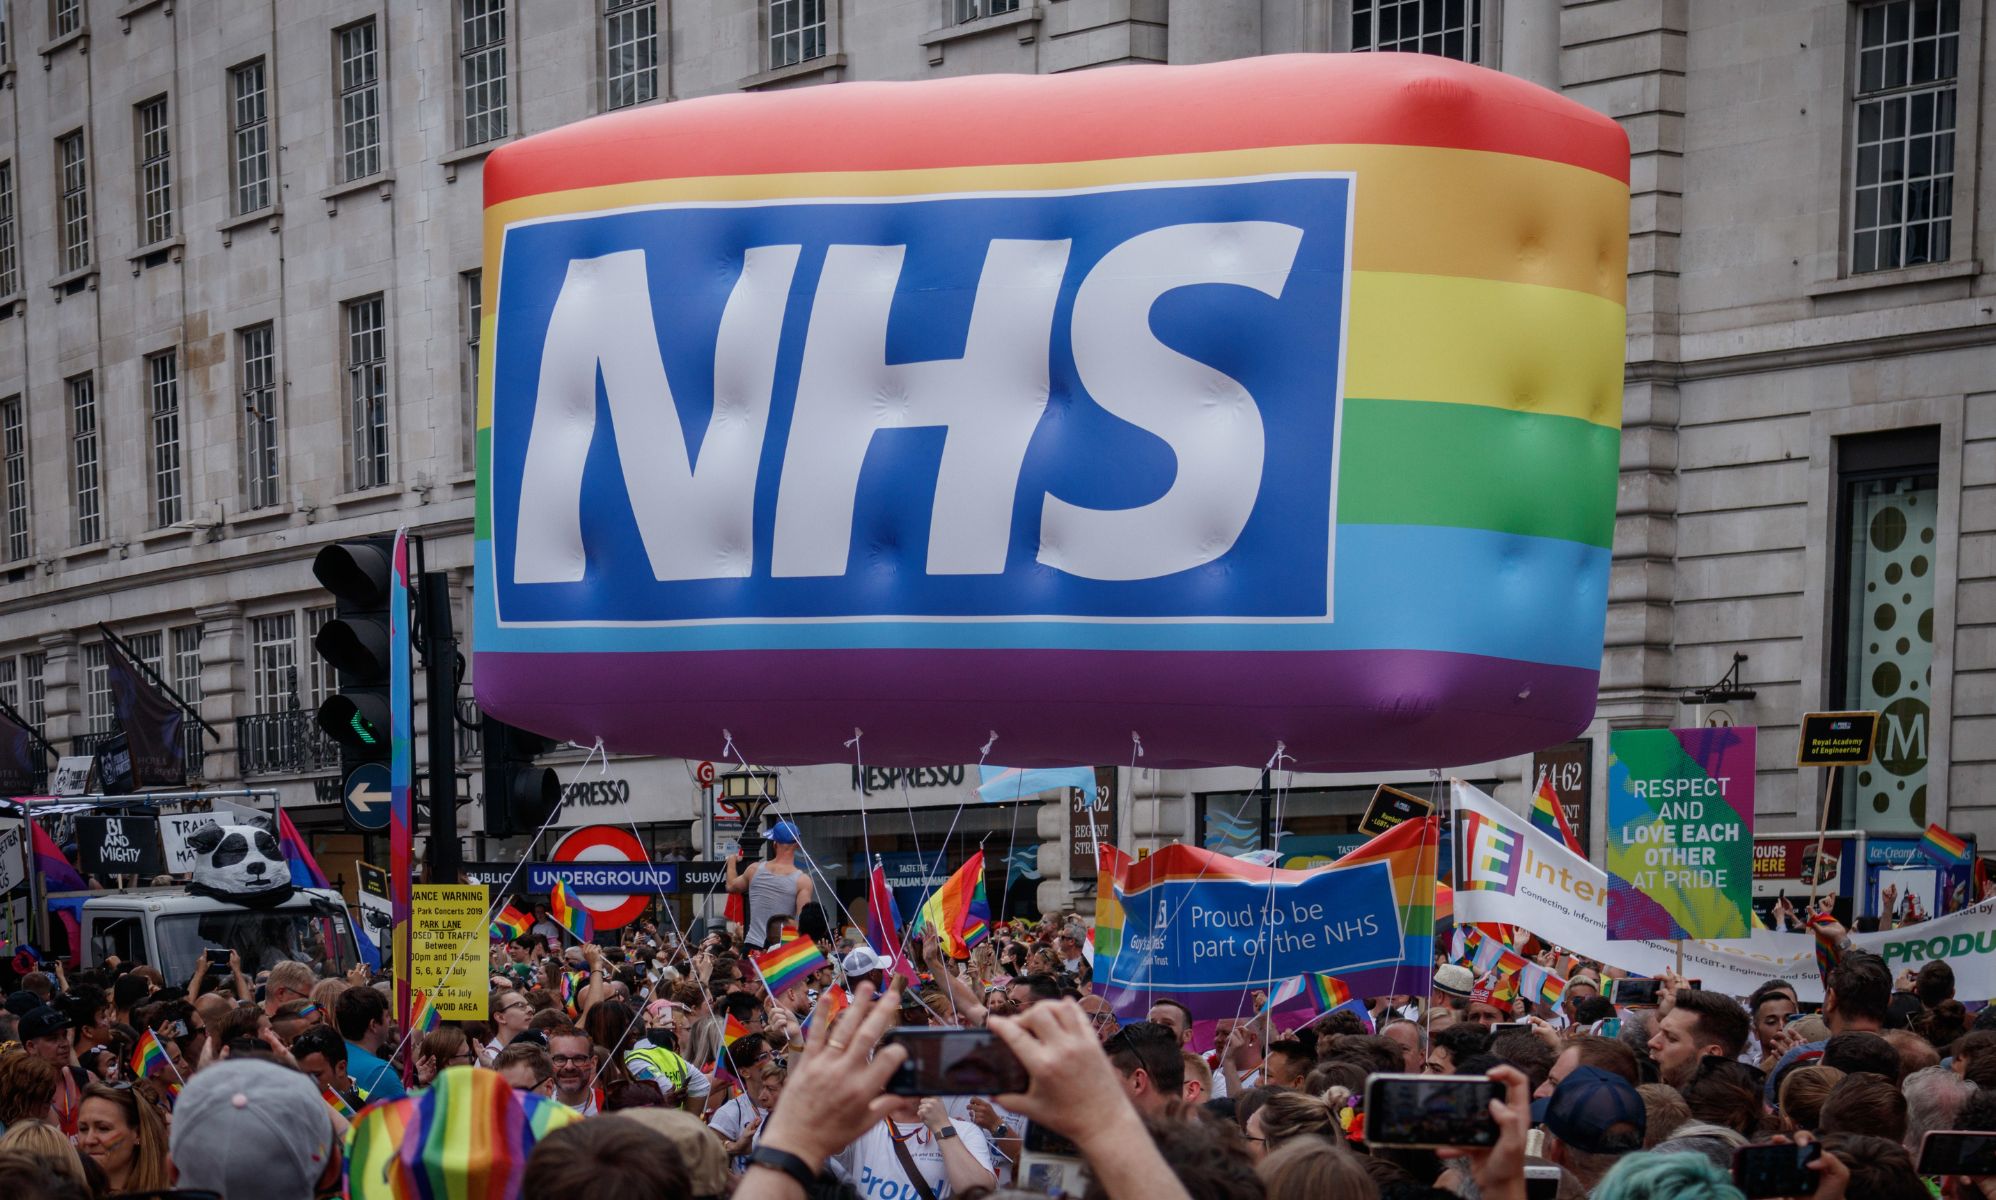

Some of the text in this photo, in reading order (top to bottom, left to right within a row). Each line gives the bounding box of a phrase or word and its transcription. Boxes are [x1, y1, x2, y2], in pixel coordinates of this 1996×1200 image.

[513, 219, 1305, 584] NHS
[1812, 738, 1863, 746] Royal Academy
[1884, 713, 1927, 760] M
[1812, 746, 1861, 755] of Engineering
[852, 765, 965, 796] NESPRESSO
[1634, 777, 1730, 799] RESPECT
[1658, 801, 1704, 820] AND
[106, 818, 122, 837] BI
[172, 818, 215, 836] TRAN
[1075, 825, 1109, 837] REGNT
[1622, 823, 1739, 845] LOVE EACH
[104, 835, 129, 848] AND
[100, 845, 141, 863] MIGHTY
[1645, 847, 1716, 866] OTHER
[1753, 858, 1785, 872] HERE
[534, 871, 672, 886] UNDERGROUND
[1525, 848, 1607, 907] Inter
[1632, 869, 1728, 889] AT PRIDE
[442, 891, 483, 902] WARNING
[1521, 886, 1570, 915] Connecting,
[435, 907, 464, 915] Concerts
[467, 907, 483, 915] 2019
[1191, 900, 1324, 928] Proud to be
[1980, 904, 1993, 915] by
[420, 920, 461, 928] PARK LANE
[435, 931, 445, 940] TO
[448, 931, 478, 940] TRAFFIC
[1193, 914, 1379, 964] part of the NHS
[425, 942, 457, 950] Between
[1882, 930, 1996, 966] PRODU
[434, 953, 447, 961] and
[415, 967, 423, 976] 5,
[436, 967, 442, 975] &
[453, 967, 467, 976] July
[1695, 956, 1727, 969] LGBT+
[1729, 965, 1777, 979] Engineers
[1780, 972, 1798, 980] and
[458, 989, 472, 998] July
[435, 1003, 478, 1011] AVOID AREA
